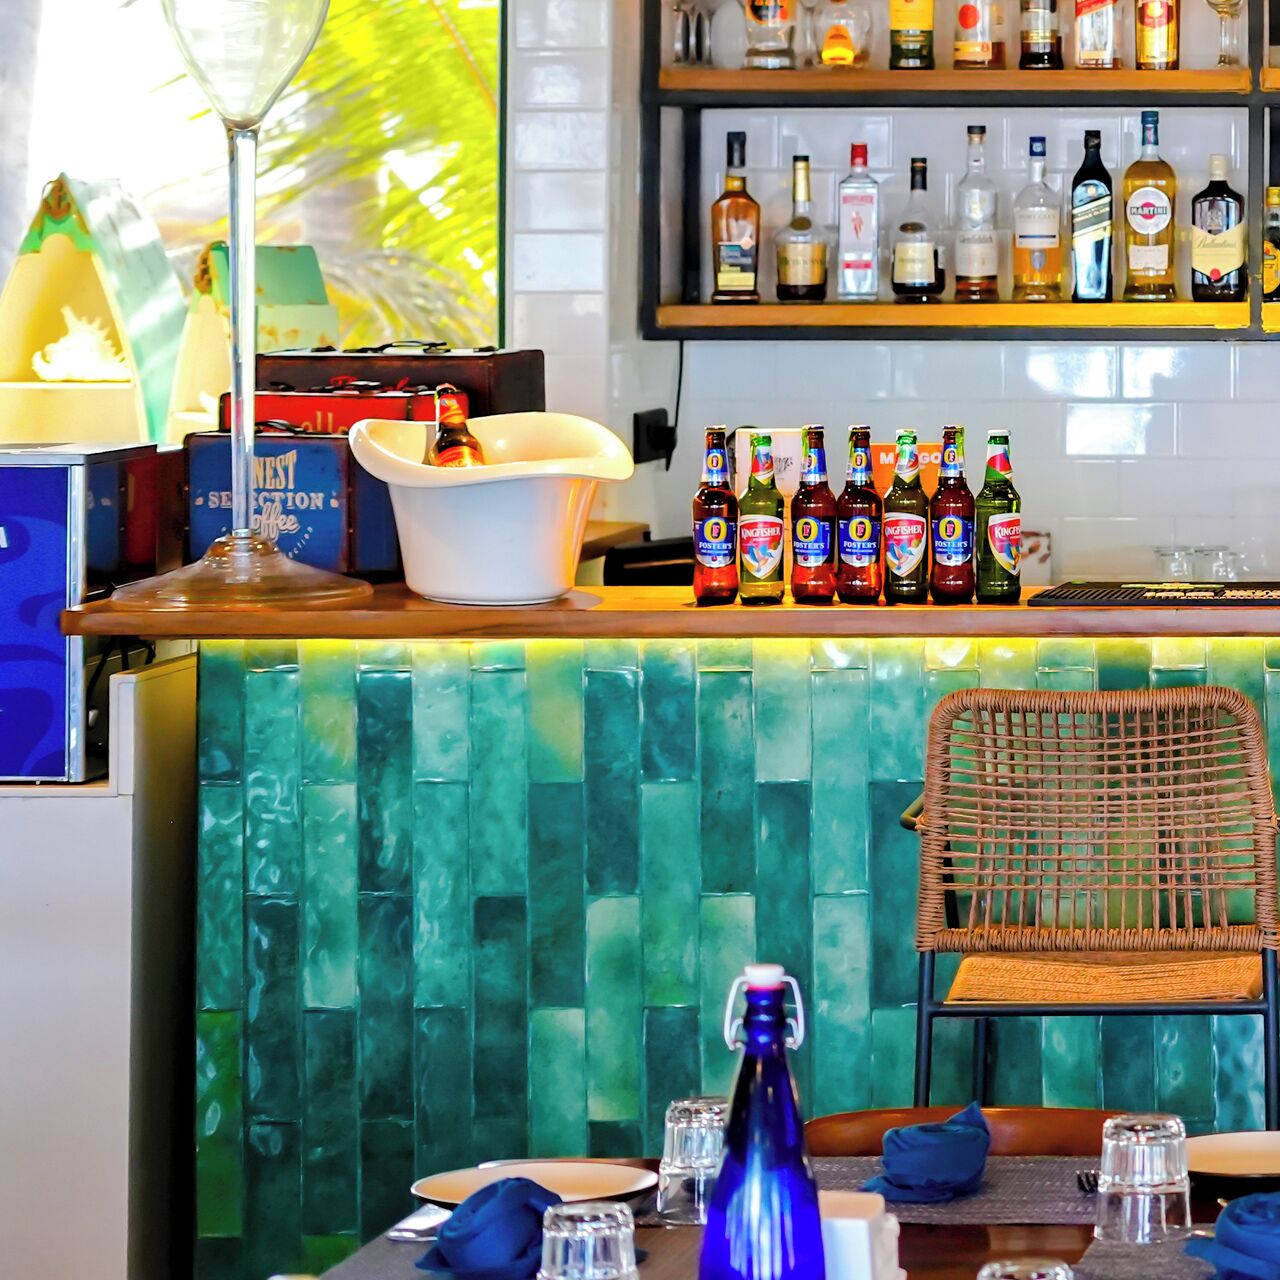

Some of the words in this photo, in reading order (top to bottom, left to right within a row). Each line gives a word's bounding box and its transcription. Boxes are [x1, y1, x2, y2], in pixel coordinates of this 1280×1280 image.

[1131, 207, 1167, 215] MARTINI
[245, 449, 297, 490] NEST
[879, 452, 942, 465] MGO
[251, 501, 302, 543] offee
